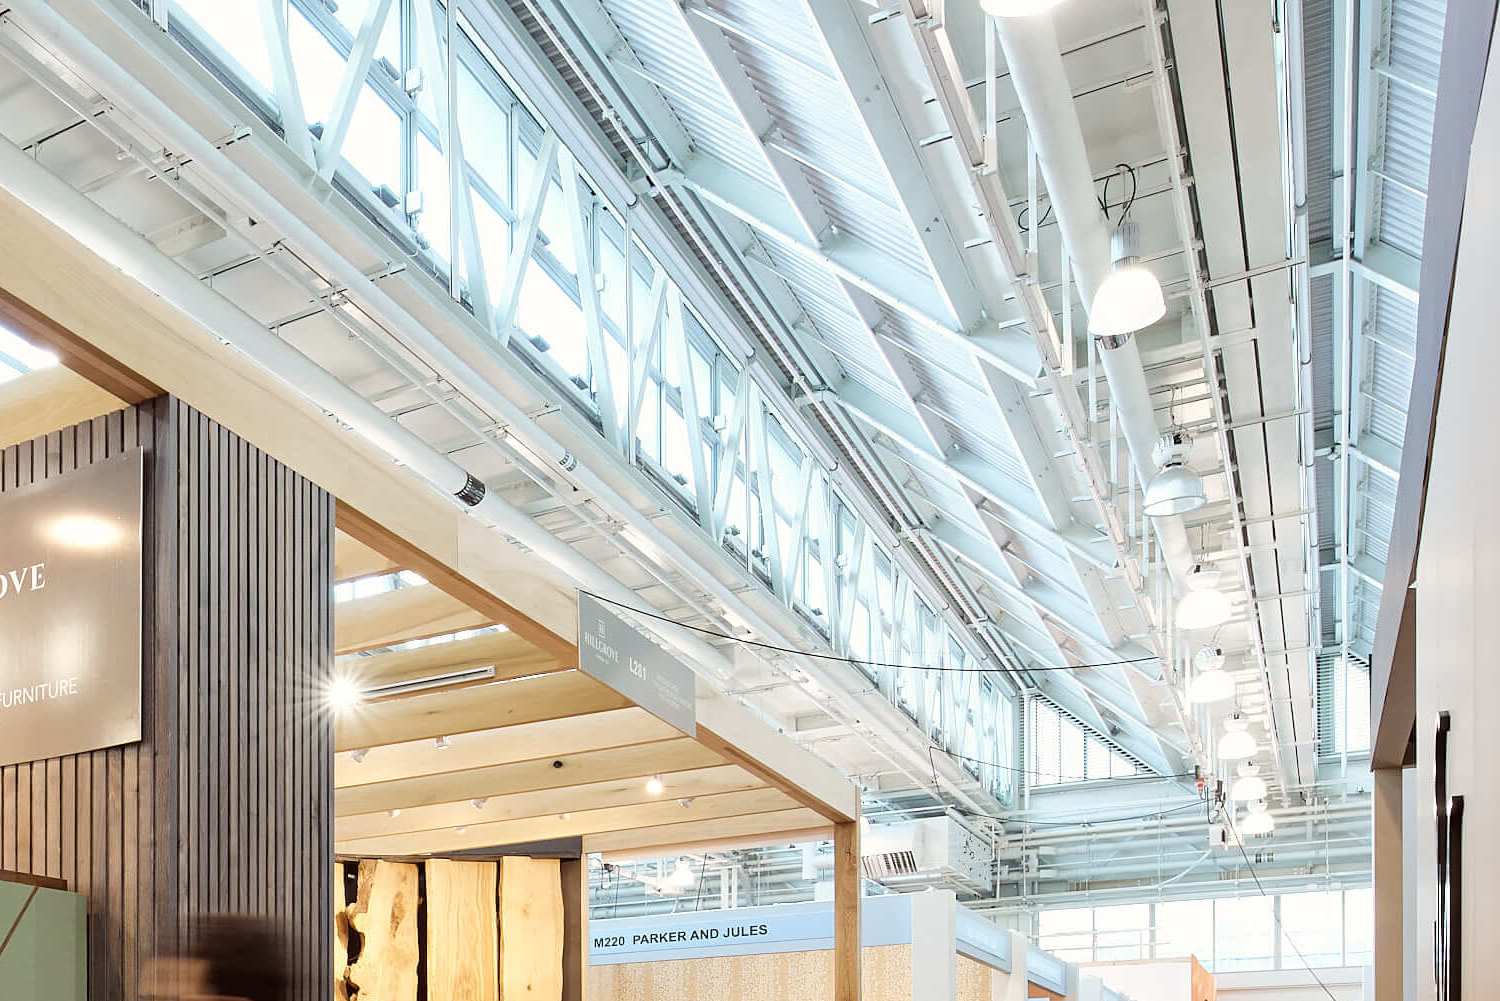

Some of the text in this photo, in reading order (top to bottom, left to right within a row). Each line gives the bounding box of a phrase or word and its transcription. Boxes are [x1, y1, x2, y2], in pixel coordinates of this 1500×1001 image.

[584, 631, 619, 664] HILLGROVE
[629, 656, 646, 680] L281
[594, 924, 768, 948] M220 PARKER AND JULES
